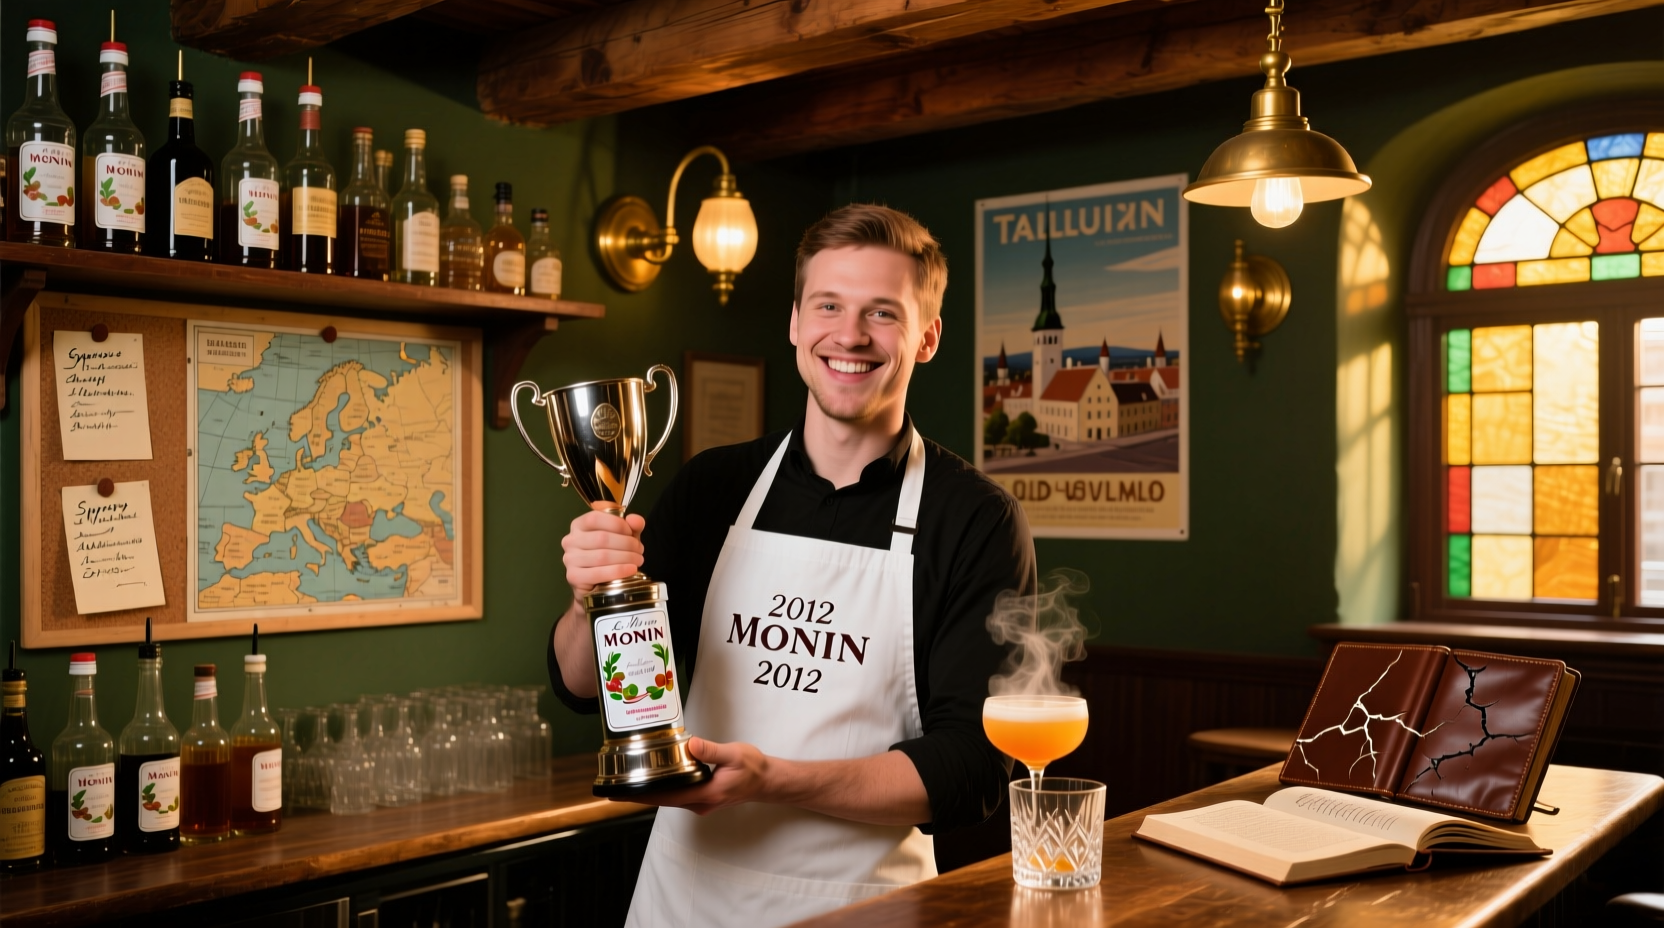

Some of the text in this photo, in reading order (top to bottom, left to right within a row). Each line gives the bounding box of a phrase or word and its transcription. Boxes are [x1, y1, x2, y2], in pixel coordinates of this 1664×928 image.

[768, 594, 835, 625] 2012
[604, 626, 664, 648] MONIN
[726, 613, 870, 666] MONIN
[753, 660, 822, 694] 2012
